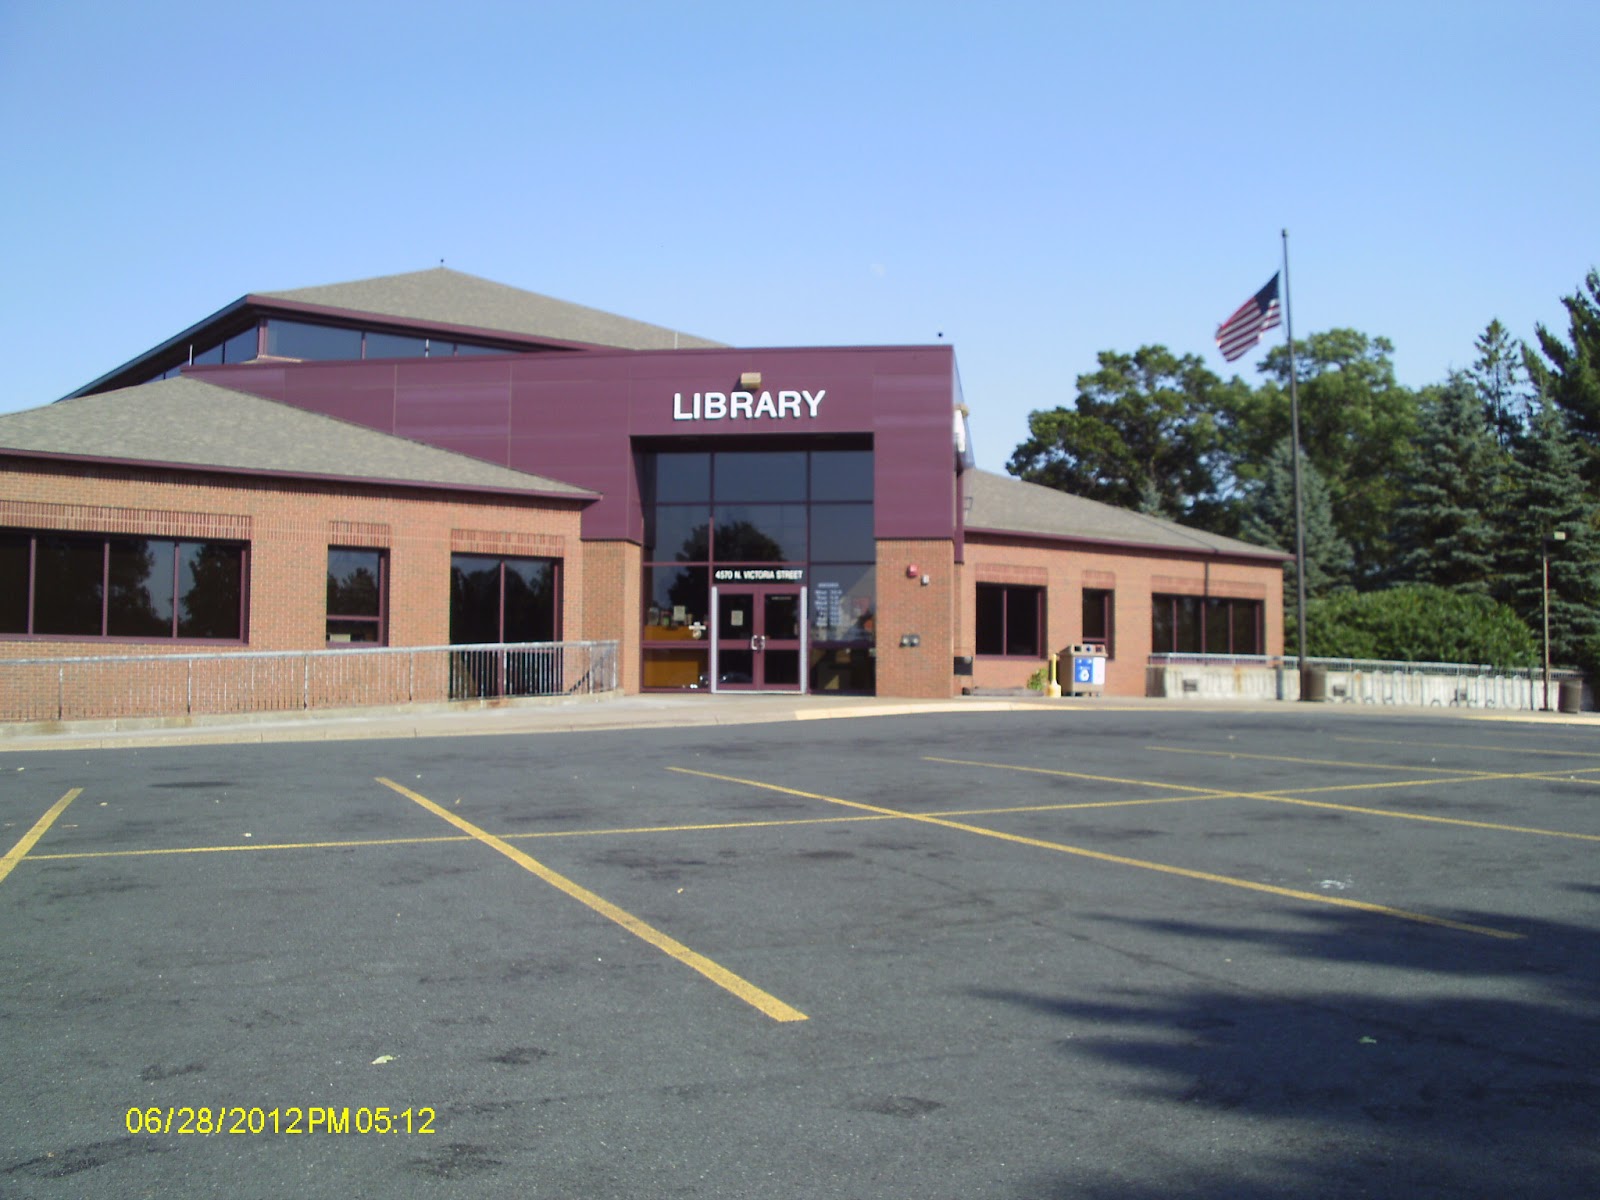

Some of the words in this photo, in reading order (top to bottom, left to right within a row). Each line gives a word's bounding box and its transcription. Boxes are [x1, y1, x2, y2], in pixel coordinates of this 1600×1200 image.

[673, 390, 826, 420] LIBRARY
[715, 570, 733, 580] 4570
[743, 570, 775, 580] VICTORIA
[776, 570, 803, 580] STREET
